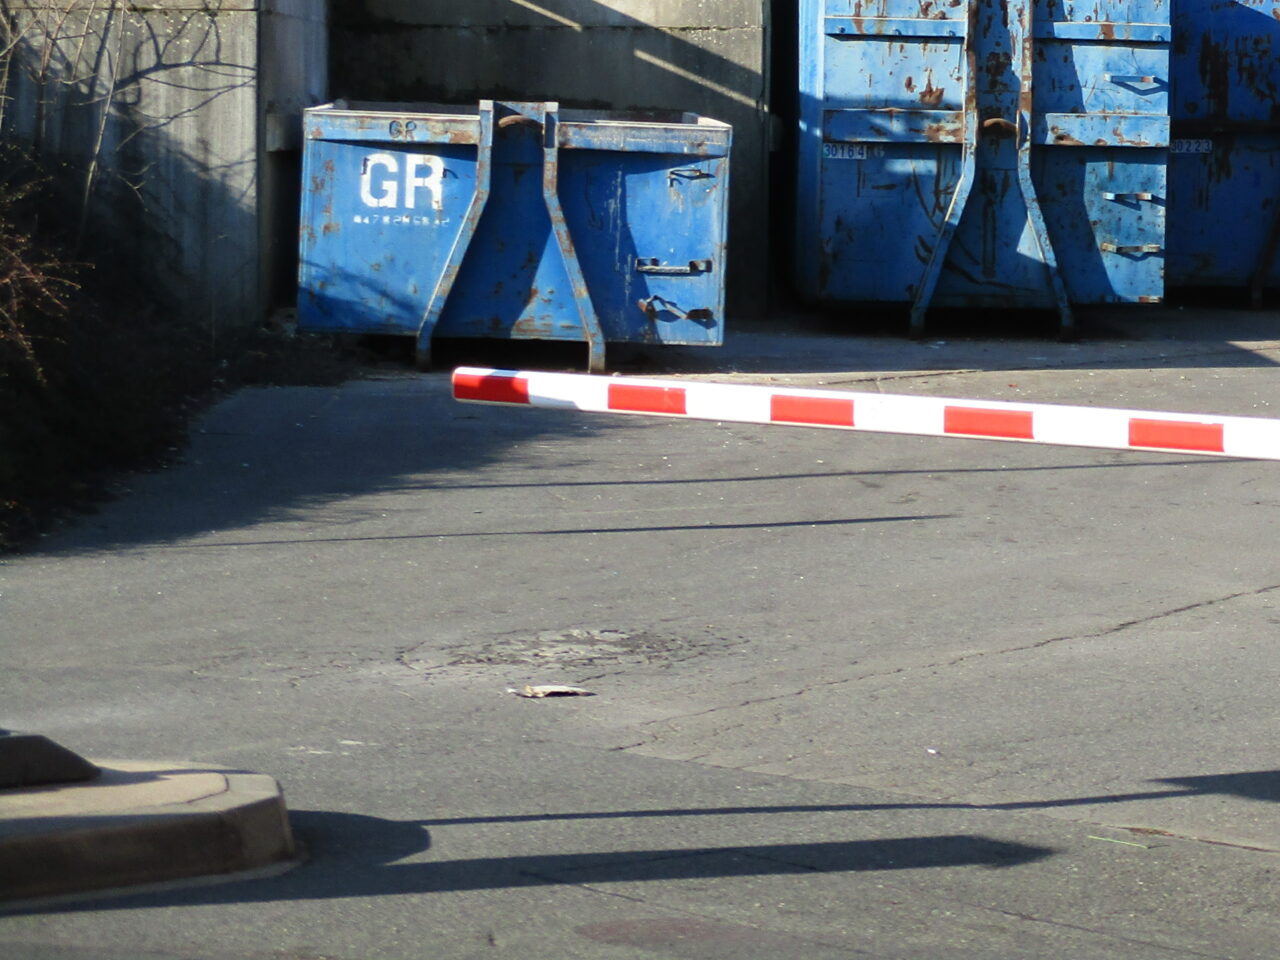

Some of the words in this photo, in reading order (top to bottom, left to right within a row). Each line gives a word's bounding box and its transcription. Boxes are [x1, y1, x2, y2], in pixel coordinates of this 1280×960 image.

[388, 120, 417, 142] GR
[823, 143, 865, 159] 30164
[360, 152, 446, 210] GR
